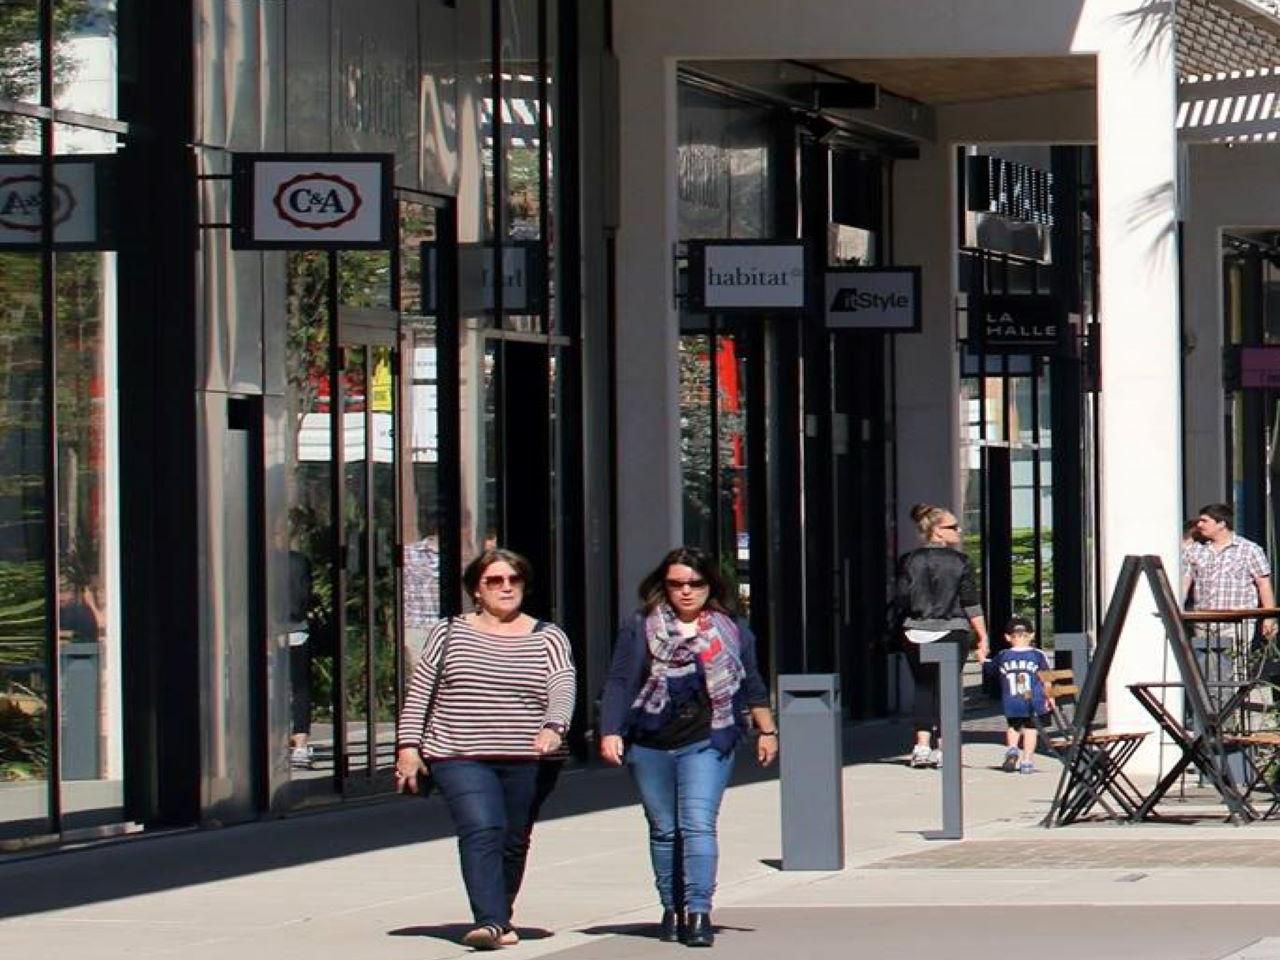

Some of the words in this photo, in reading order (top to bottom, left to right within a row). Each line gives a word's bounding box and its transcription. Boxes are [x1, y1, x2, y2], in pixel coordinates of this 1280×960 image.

[289, 188, 346, 213] C&A
[708, 267, 789, 286] habitat
[987, 311, 1014, 323] LA
[986, 325, 1057, 337] HALLE
